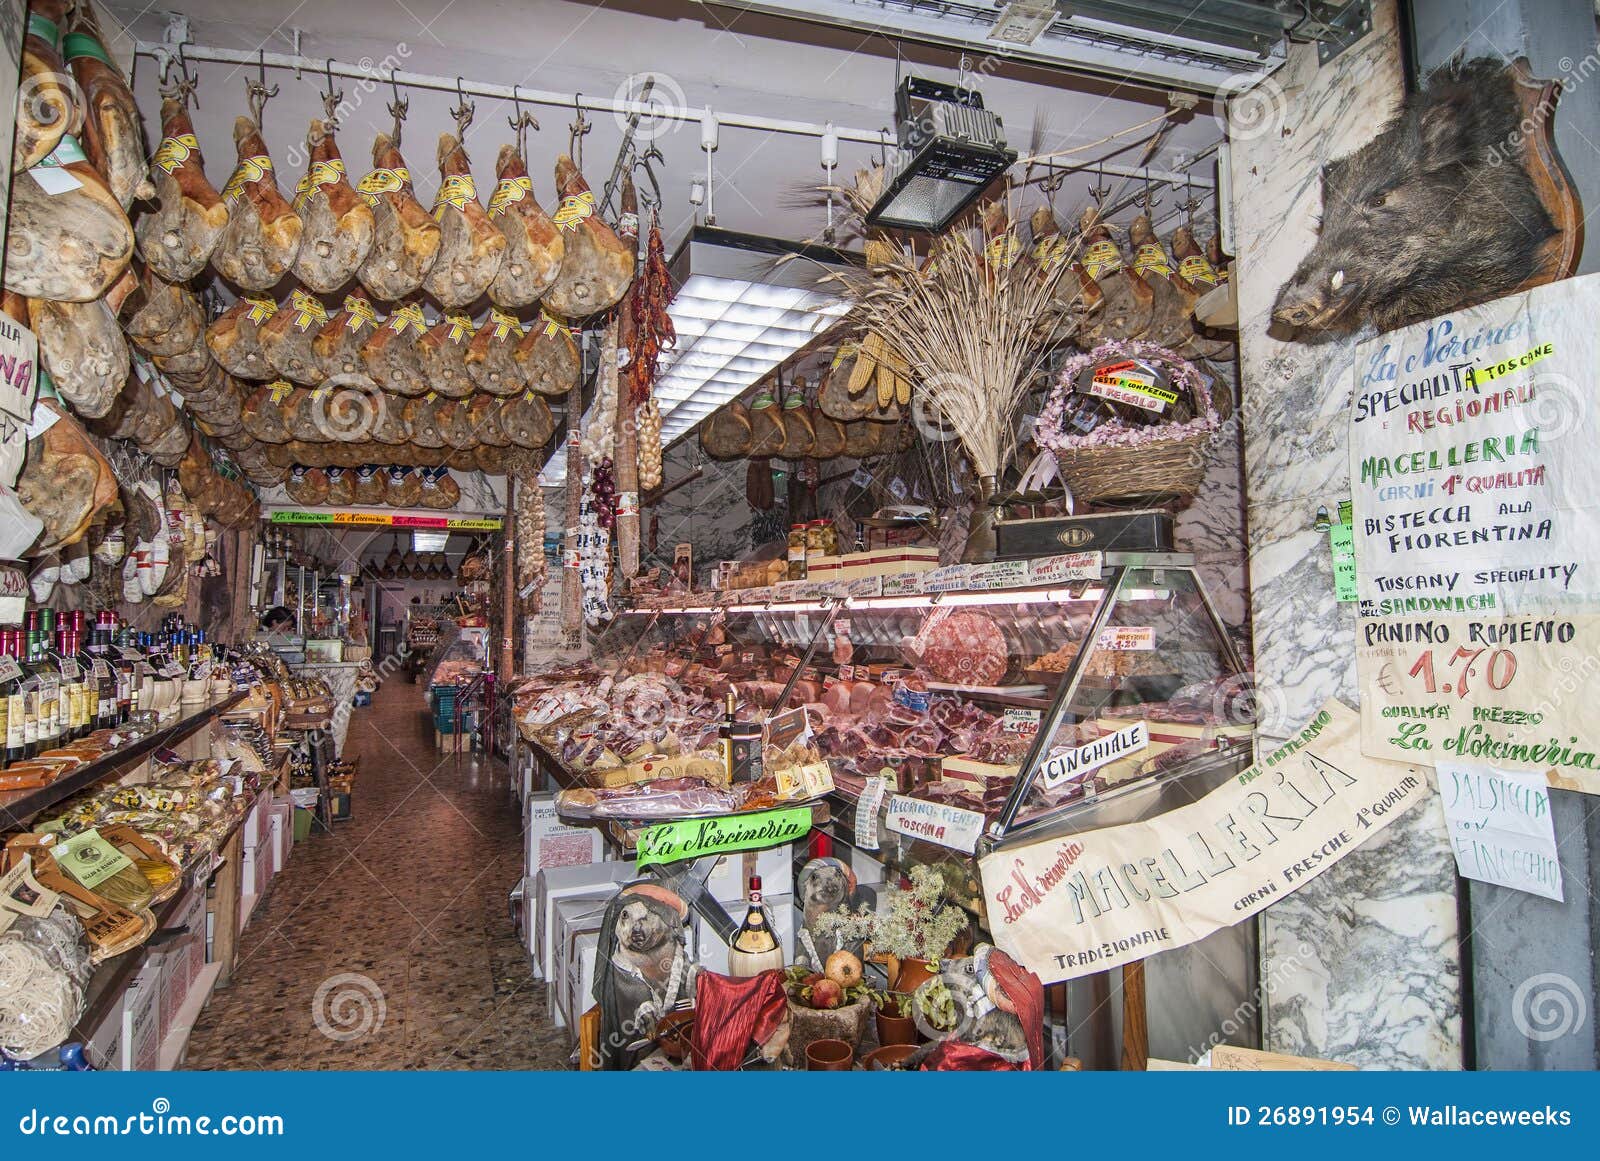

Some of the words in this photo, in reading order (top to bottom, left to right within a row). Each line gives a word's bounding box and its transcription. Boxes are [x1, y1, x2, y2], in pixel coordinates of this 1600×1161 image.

[0, 320, 20, 344] LLA
[1361, 344, 1399, 388] La
[1484, 343, 1553, 381] TOSCANE
[1407, 374, 1537, 434] REGIONALI
[1361, 426, 1540, 489] MACELLERIA
[1379, 478, 1435, 502] CARNI
[1365, 505, 1471, 536] BISTECCA
[1499, 500, 1532, 515] ALLA
[1388, 519, 1552, 553] FIORENTINA
[1374, 572, 1460, 593] TUSCANY
[1474, 562, 1579, 590] SPECIALITY
[1360, 599, 1374, 608] WE
[1379, 592, 1497, 616] SANDWICH
[1365, 620, 1450, 647] PANINO
[1469, 620, 1576, 647] RIPIENO
[1472, 705, 1544, 726] PREZZO
[1047, 726, 1141, 780] CINGHIALE
[1265, 710, 1333, 768] INTERNO
[1388, 721, 1434, 751] La
[1442, 723, 1600, 770] Norcineria
[639, 825, 675, 861] La
[683, 818, 803, 852] Norcineria
[898, 817, 946, 839] TOSCANA
[1065, 750, 1358, 925] MACELLERIA
[1017, 838, 1084, 907] Norcineria
[1233, 879, 1278, 912] CARNI
[1283, 829, 1353, 883] FRESCHE
[1053, 928, 1171, 970] TRADIZIONALE
